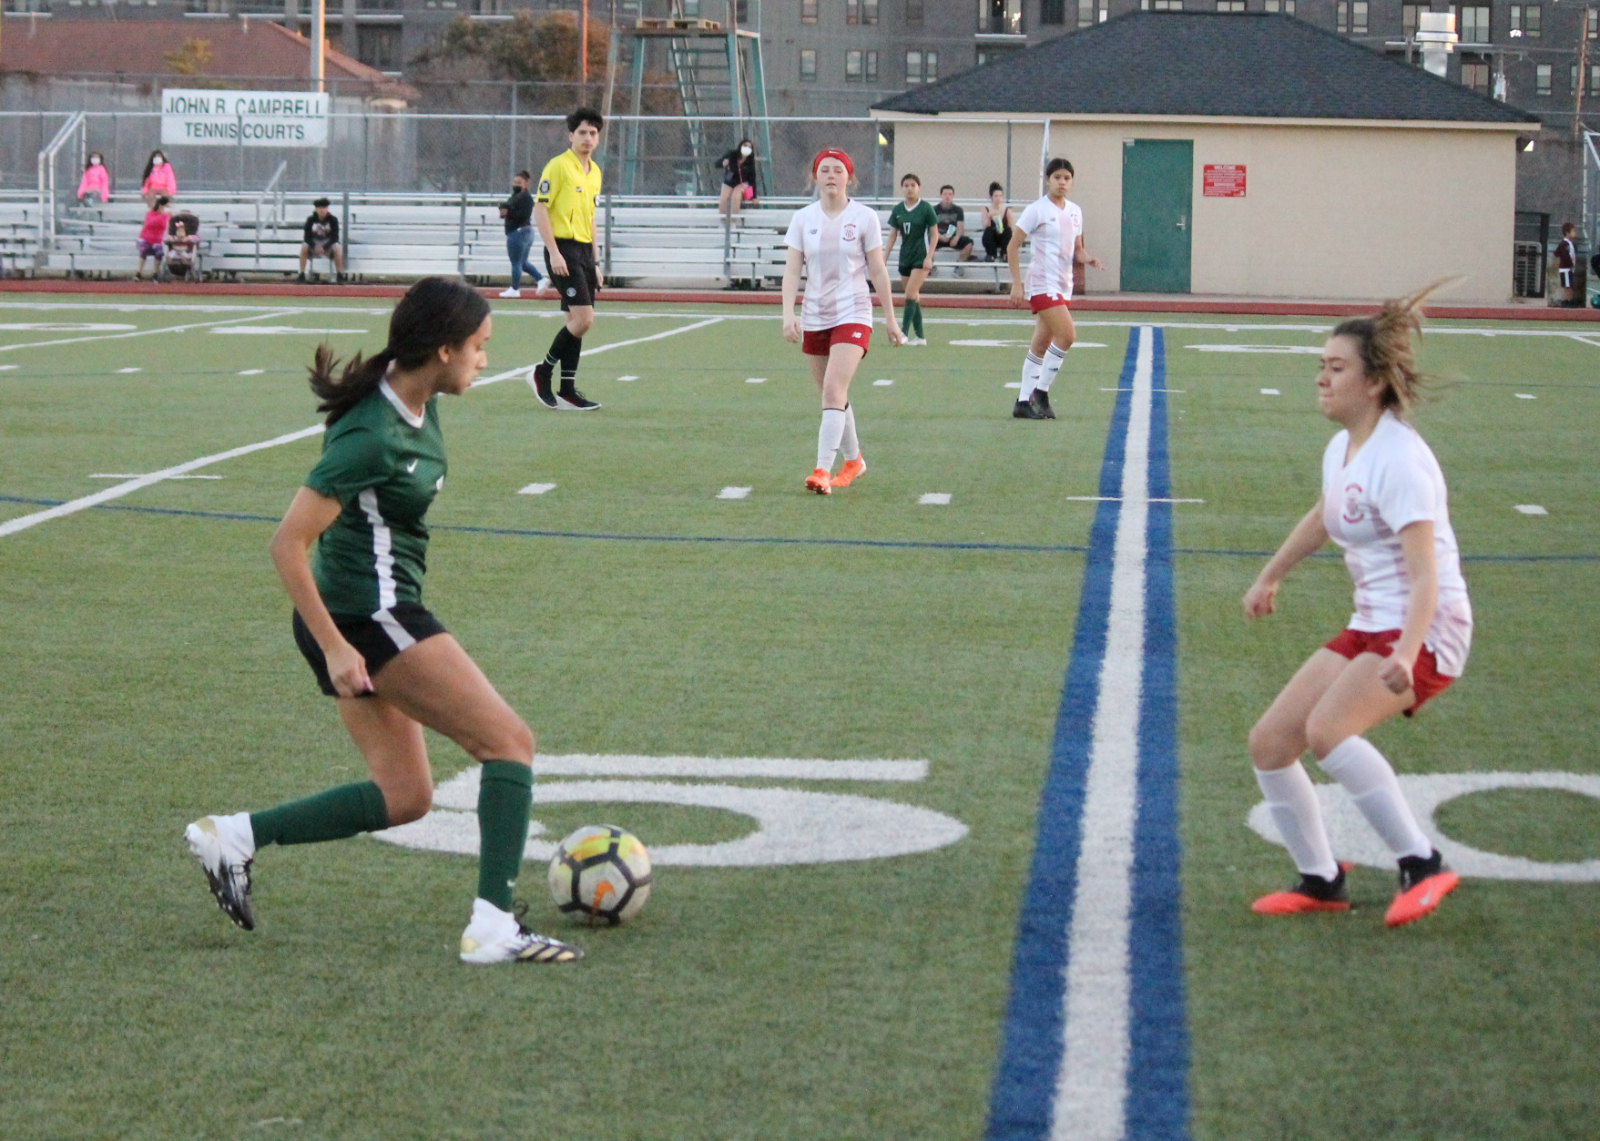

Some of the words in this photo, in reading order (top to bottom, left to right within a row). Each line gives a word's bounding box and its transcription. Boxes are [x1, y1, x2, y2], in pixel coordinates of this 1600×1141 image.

[166, 97, 210, 116] JOHN
[235, 98, 325, 118] CAMPBELL
[184, 122, 238, 138] TENNIS
[242, 123, 305, 140] COURTS
[902, 221, 911, 235] 17
